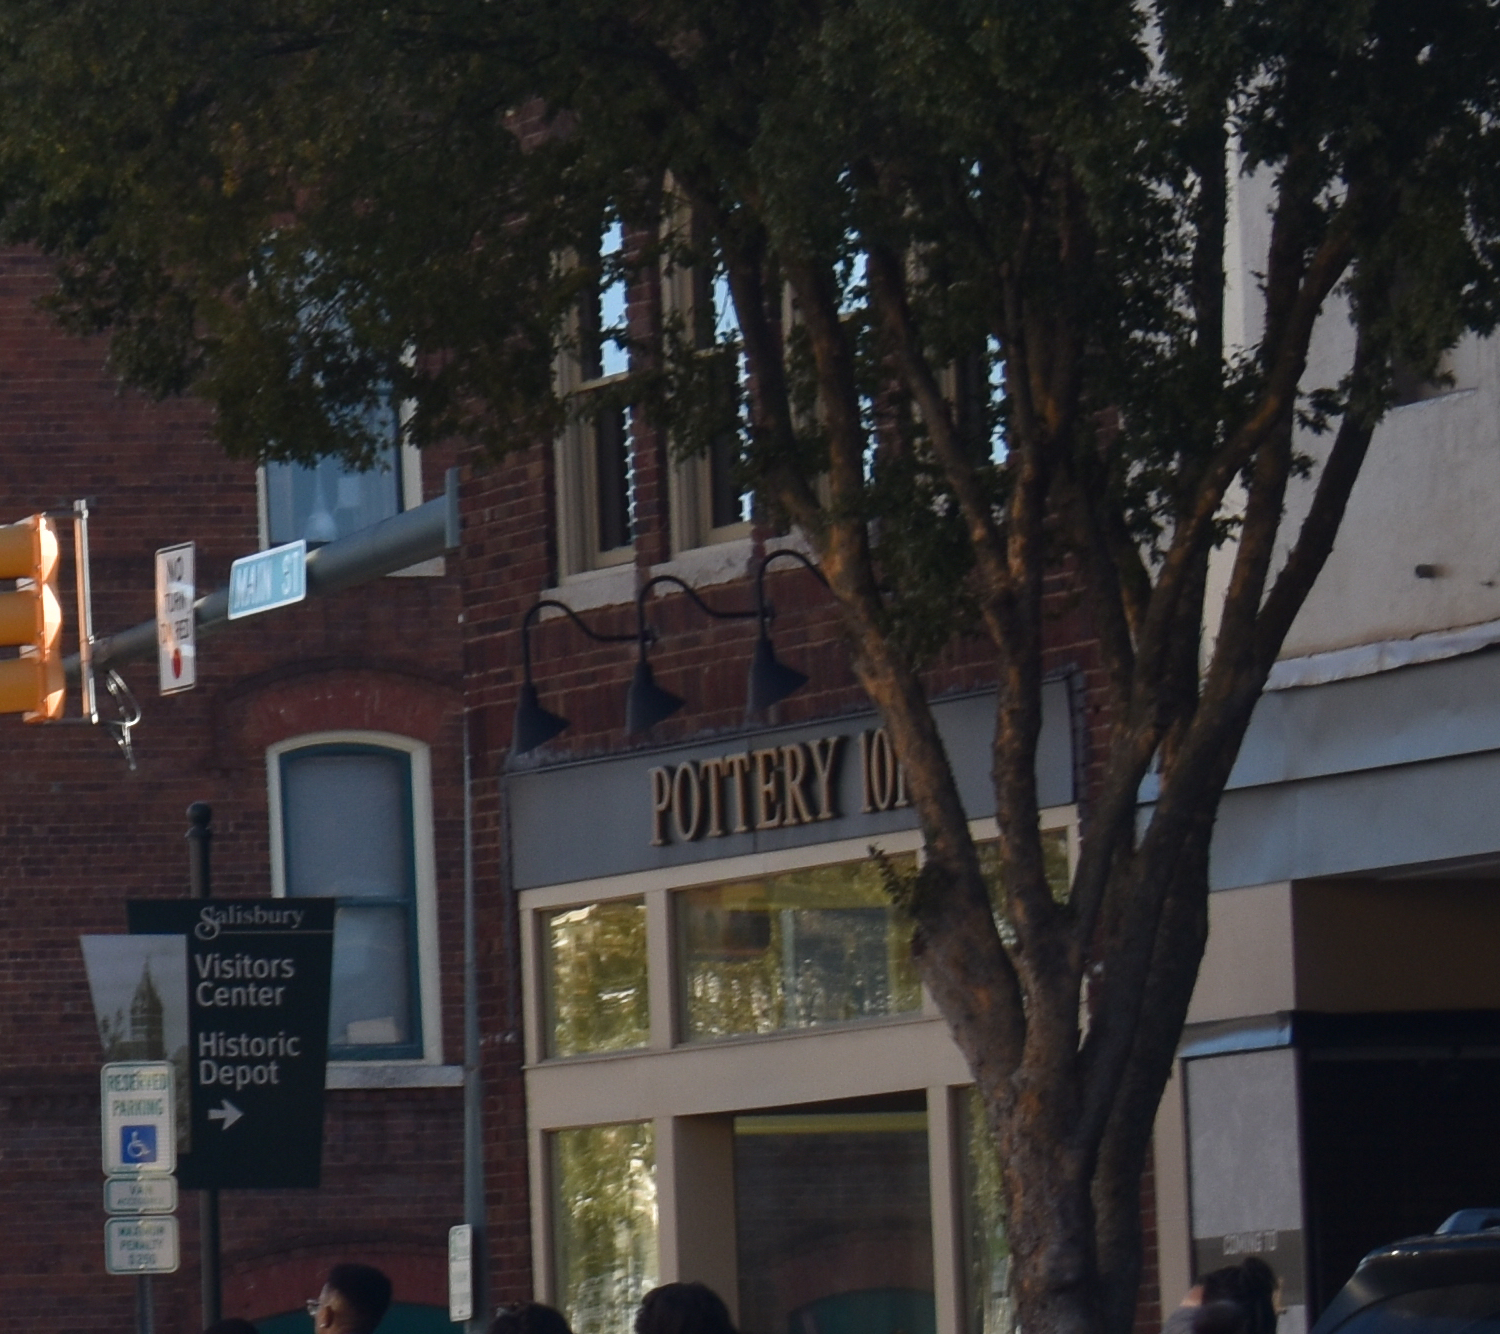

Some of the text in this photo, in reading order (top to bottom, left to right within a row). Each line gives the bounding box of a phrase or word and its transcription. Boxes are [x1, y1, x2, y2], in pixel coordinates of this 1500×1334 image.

[166, 556, 184, 583] NO
[234, 551, 300, 608] MAIN ST
[648, 735, 841, 846] POTTERY
[194, 904, 305, 940] Salisbury
[194, 953, 296, 979] Visitors
[195, 981, 287, 1007] Center
[198, 1030, 302, 1058] Historic
[107, 1074, 168, 1091] RESERVED
[199, 1059, 280, 1092] Depot
[113, 1098, 164, 1116] PARKING
